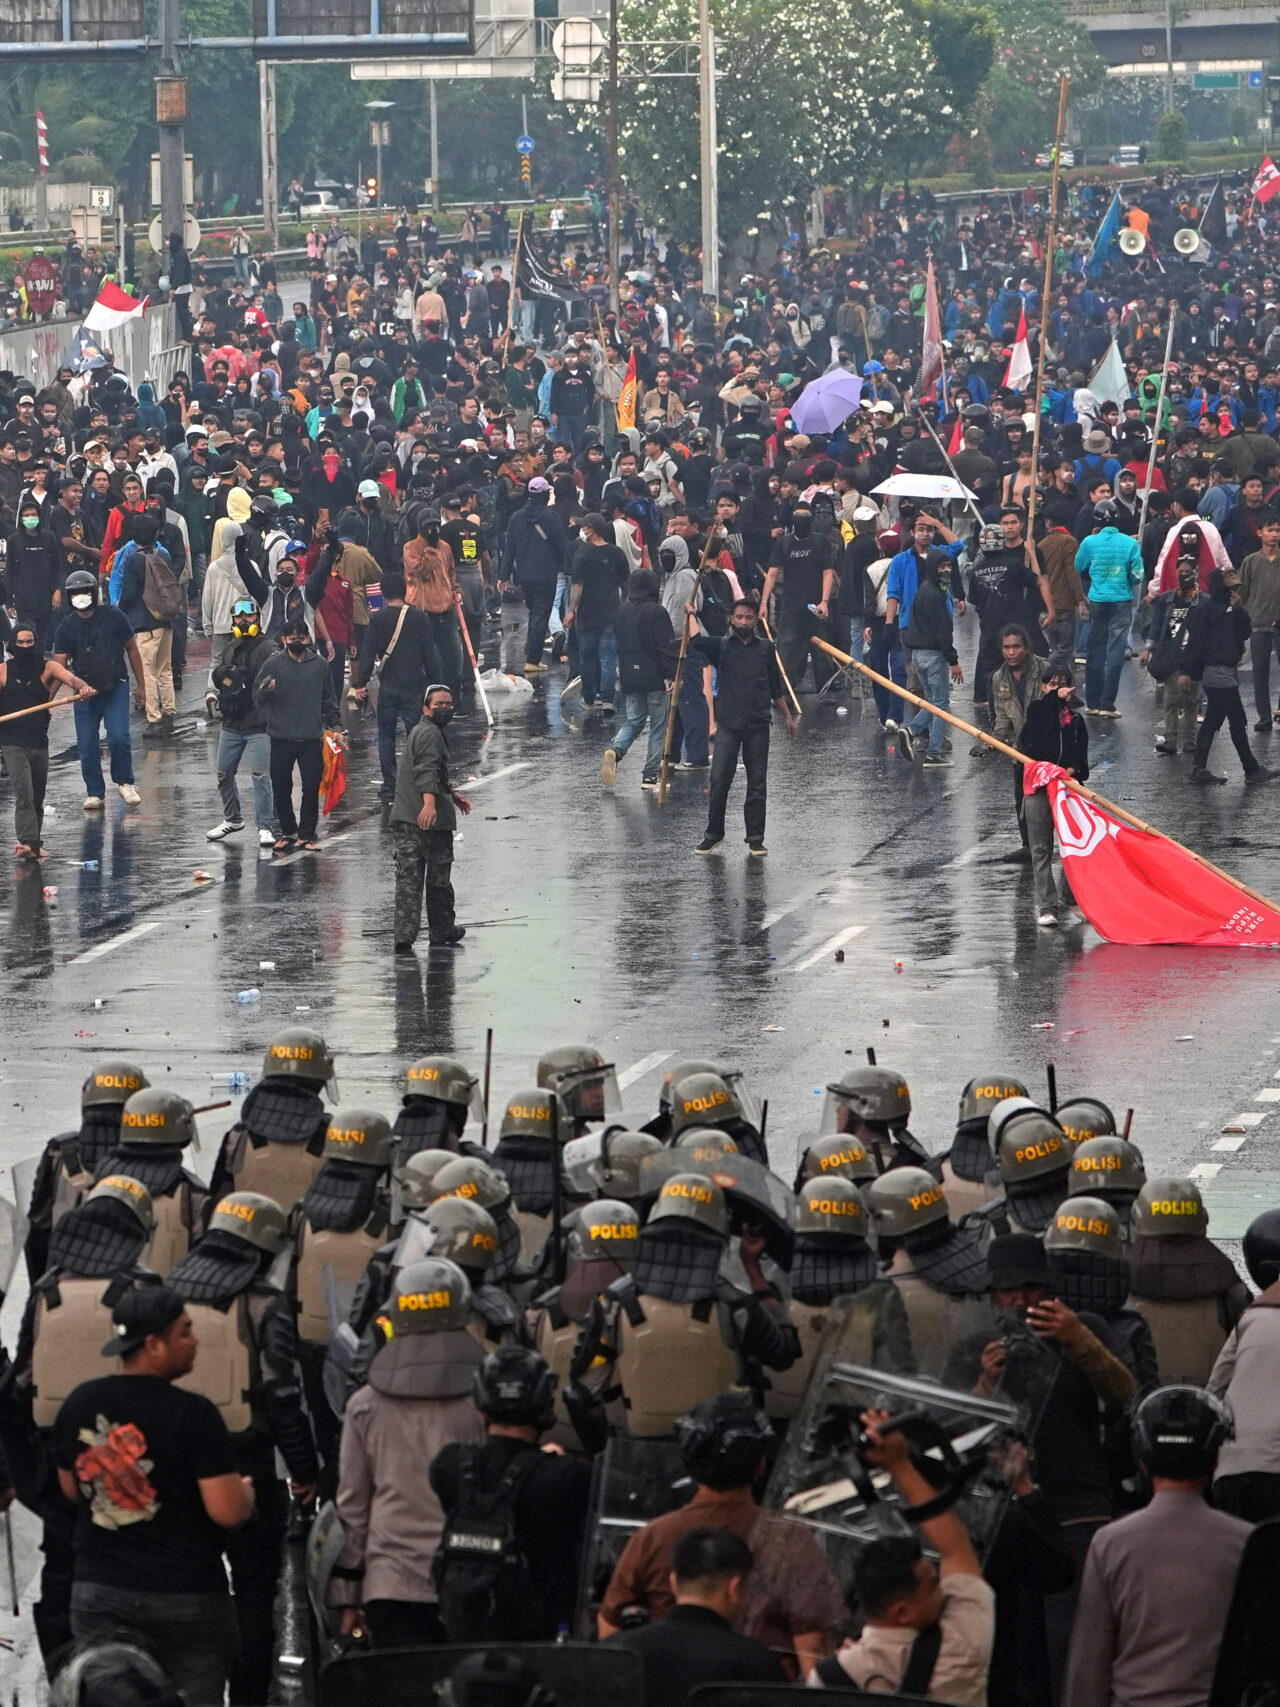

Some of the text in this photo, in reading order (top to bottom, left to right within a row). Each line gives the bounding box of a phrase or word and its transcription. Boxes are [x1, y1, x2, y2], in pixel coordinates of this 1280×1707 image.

[98, 196, 104, 206] 9
[271, 1045, 313, 1060] POLISI
[95, 1074, 140, 1089] POLISI
[1073, 1155, 1121, 1172] POLISI
[808, 1199, 859, 1216] POLISI
[1150, 1199, 1198, 1216] POLISI
[589, 1223, 638, 1241] POLISI
[1056, 1215, 1108, 1236] POLISI
[397, 1290, 450, 1312] POLISI
